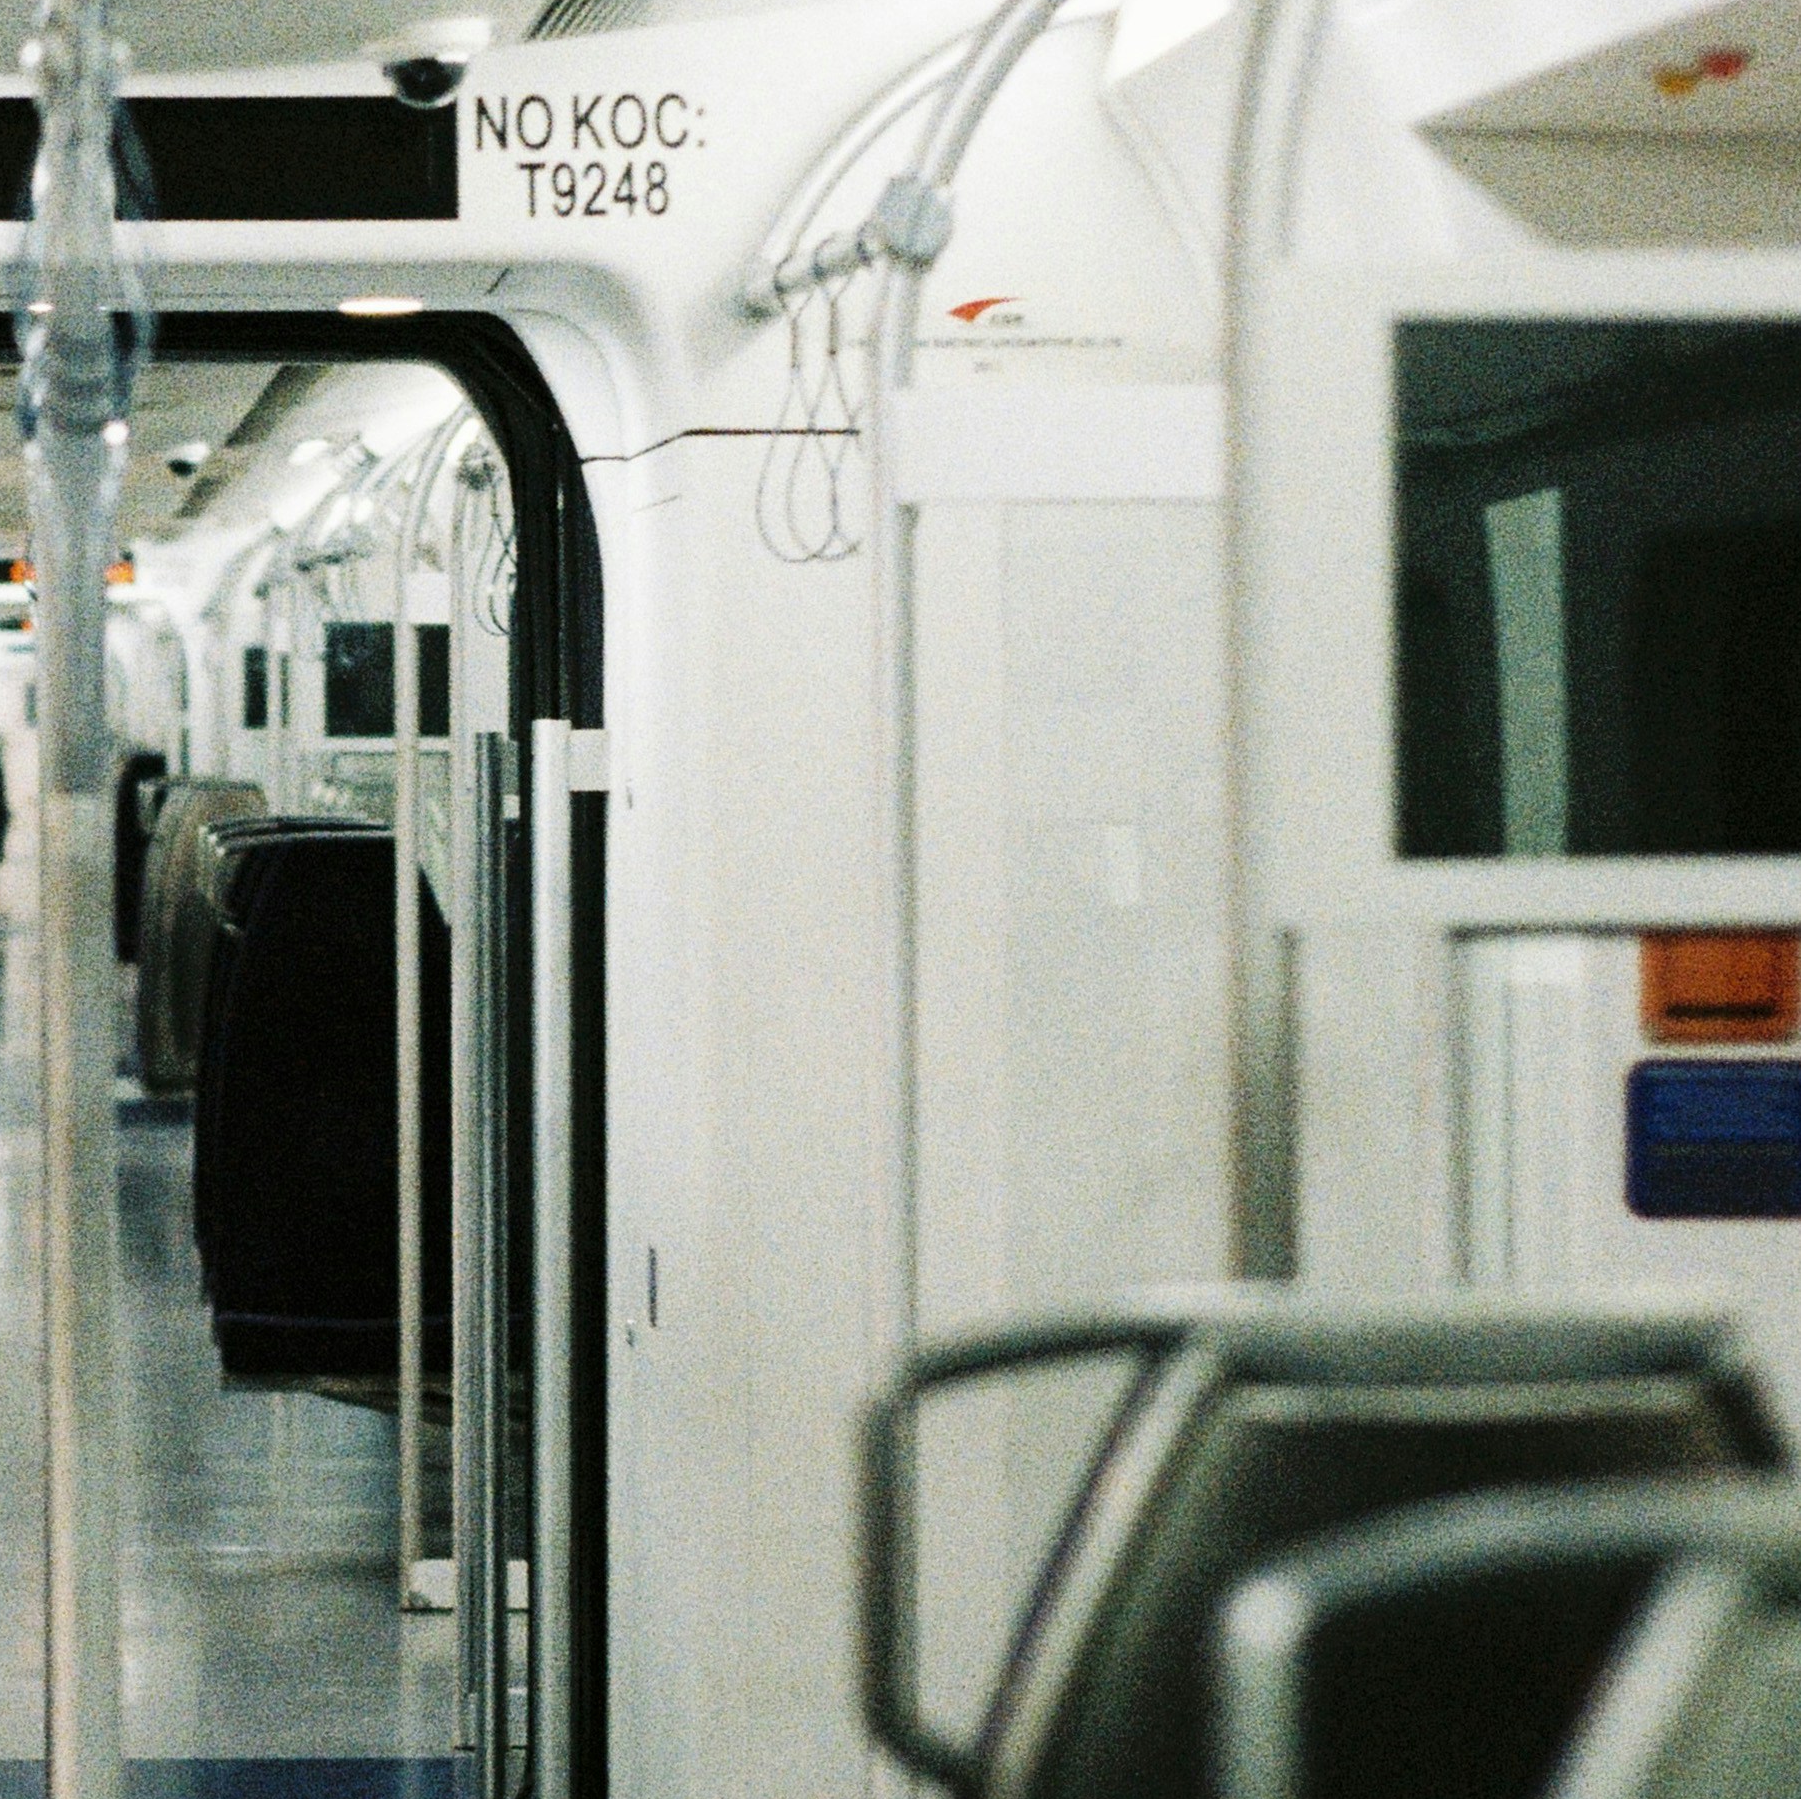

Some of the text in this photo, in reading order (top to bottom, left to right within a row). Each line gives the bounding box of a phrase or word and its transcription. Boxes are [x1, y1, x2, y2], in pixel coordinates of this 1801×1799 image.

[475, 93, 705, 150] NO KOC:
[519, 161, 669, 217] T9248
